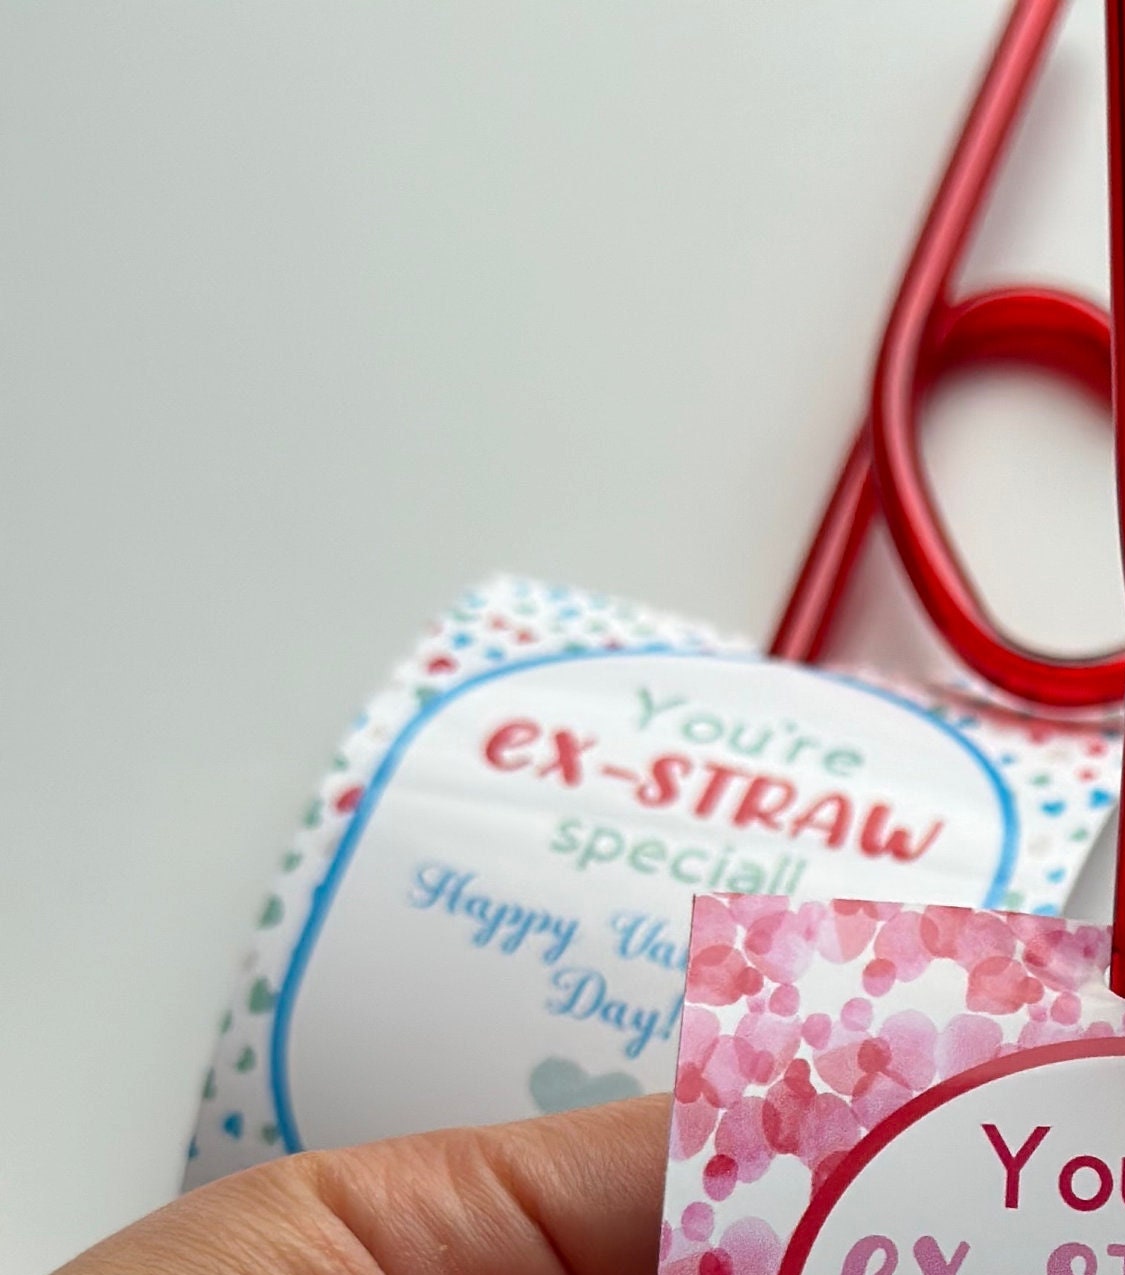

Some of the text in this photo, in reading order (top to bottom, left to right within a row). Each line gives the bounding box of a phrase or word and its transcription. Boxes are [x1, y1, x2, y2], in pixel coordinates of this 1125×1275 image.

[638, 689, 864, 775] You're
[485, 719, 943, 863] ex-STRAW
[408, 864, 581, 956] Happy
[546, 967, 685, 1058] Day!
